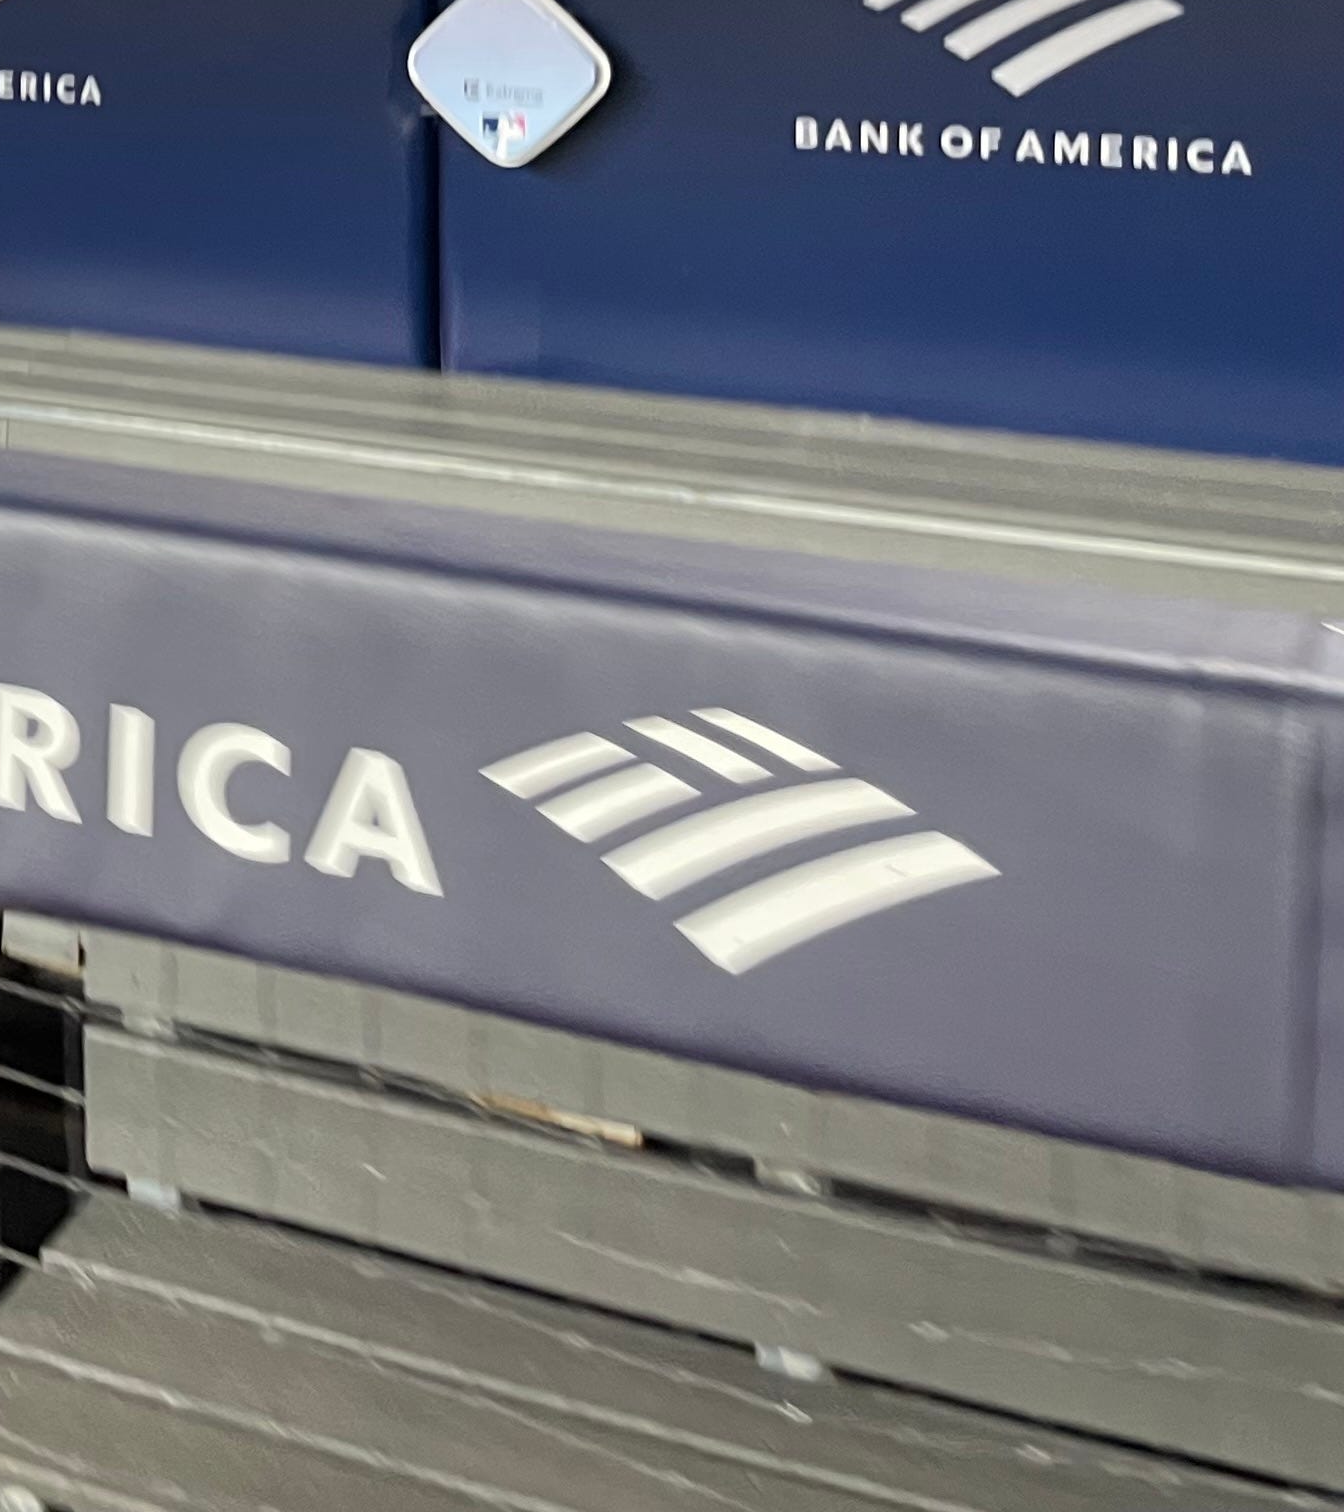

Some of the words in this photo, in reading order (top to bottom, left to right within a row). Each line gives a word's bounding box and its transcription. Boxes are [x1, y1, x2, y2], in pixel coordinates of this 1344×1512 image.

[795, 116, 924, 156] BANK
[941, 124, 1001, 161] OF
[1016, 129, 1252, 176] AMERICA
